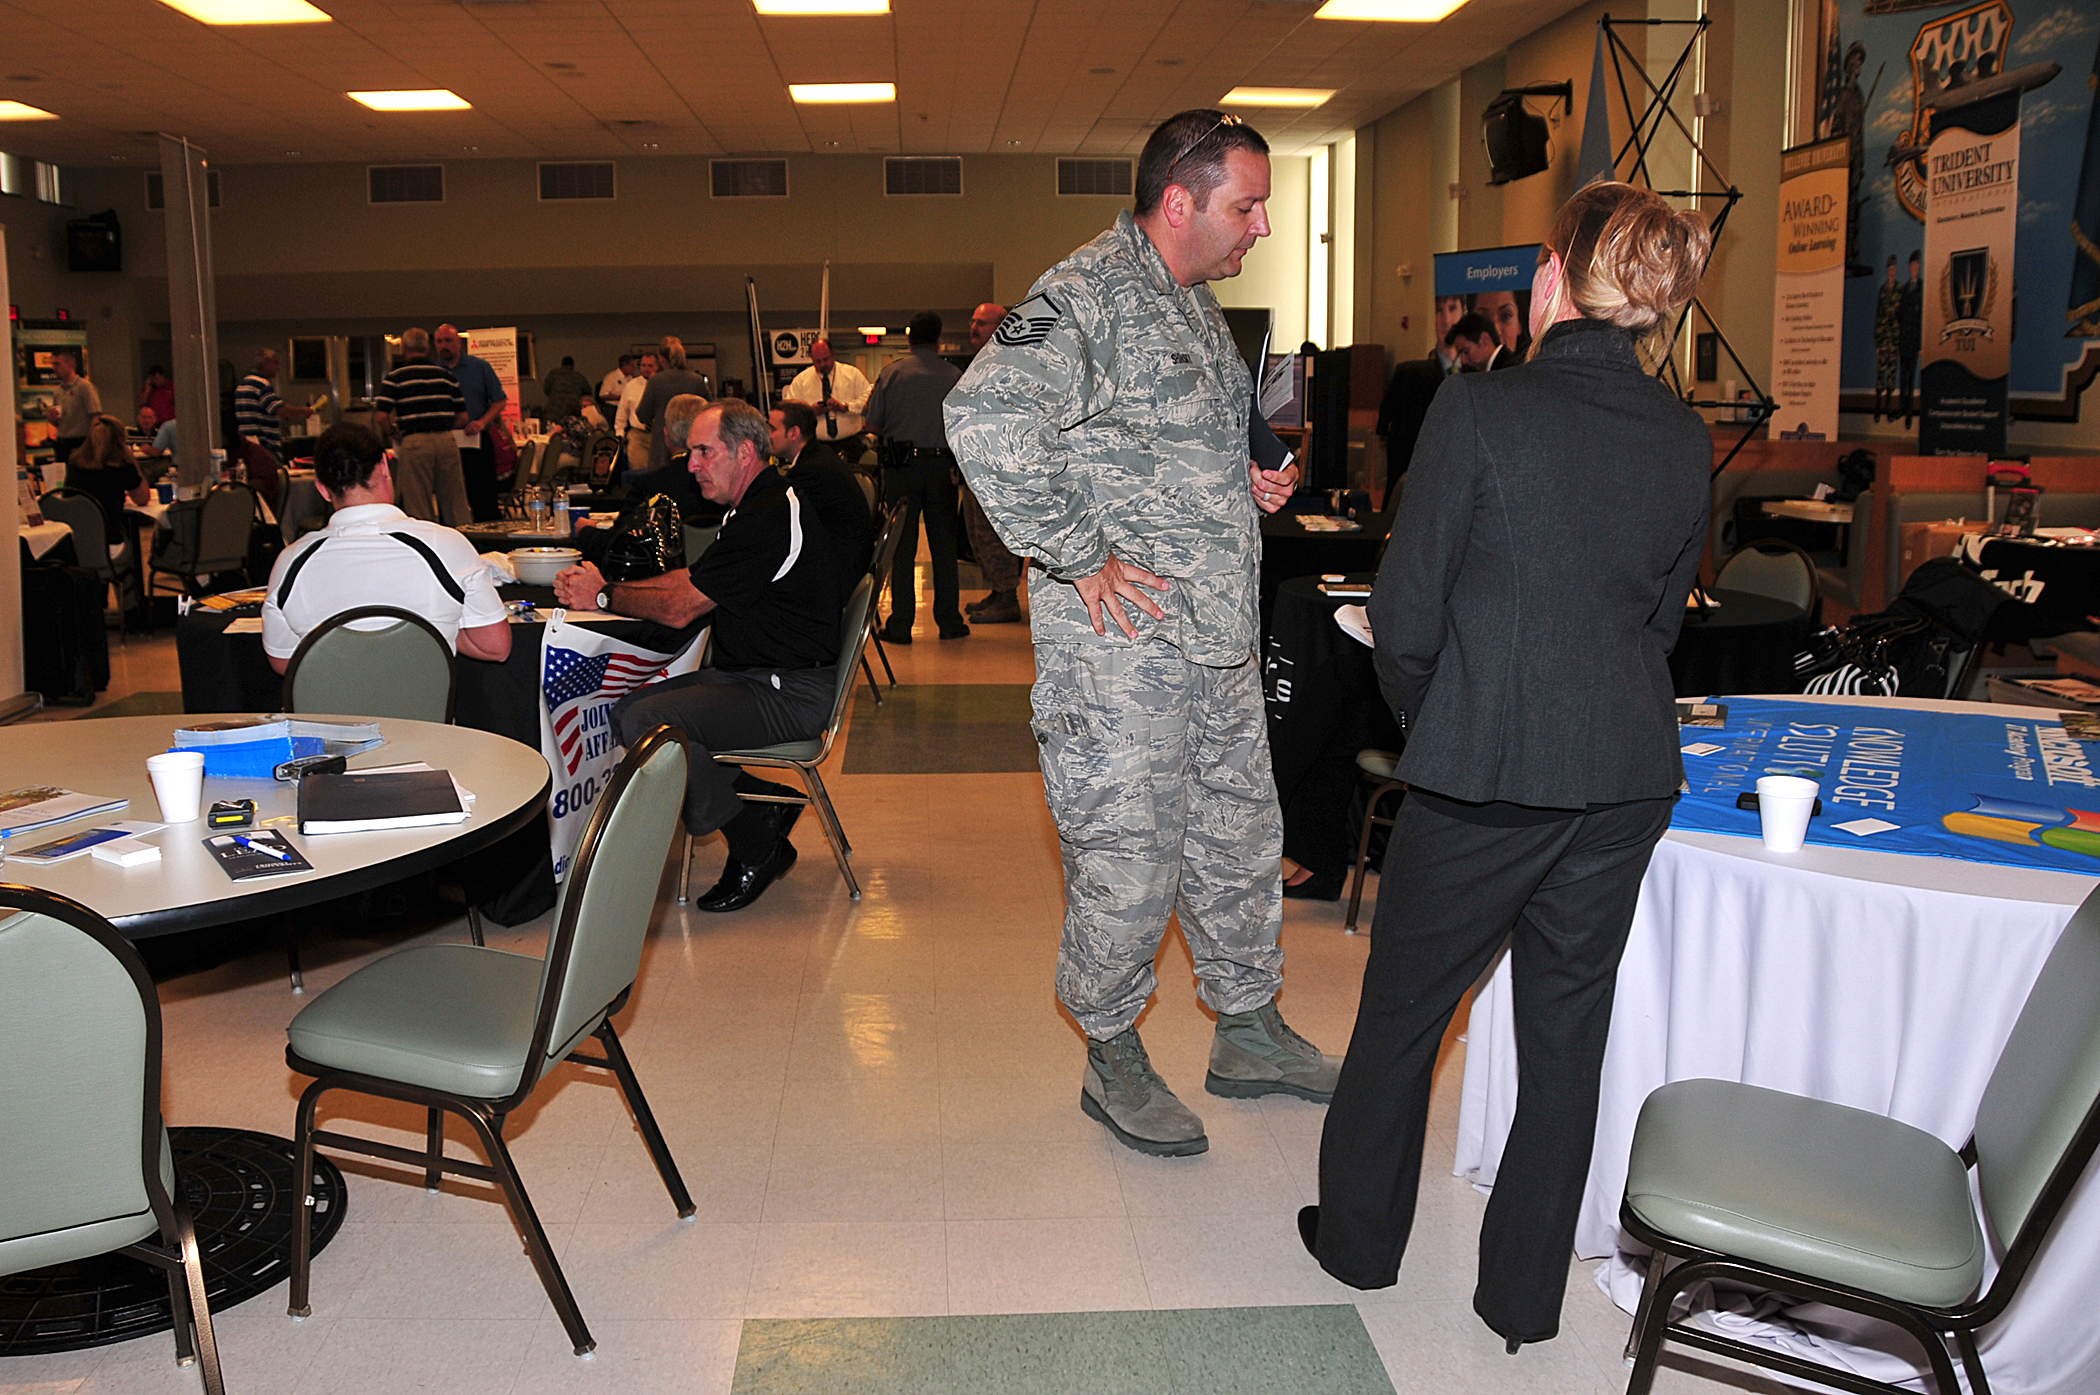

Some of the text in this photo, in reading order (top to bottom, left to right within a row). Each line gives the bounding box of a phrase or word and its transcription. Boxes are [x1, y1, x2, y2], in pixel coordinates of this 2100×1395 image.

[1933, 142, 1993, 174] TRIDENT
[1932, 159, 2016, 195] UNIVERSITY
[1783, 194, 1838, 222] AWARD-
[1793, 217, 1840, 237] WINNING
[1809, 237, 1837, 252] Learning
[1467, 265, 1519, 280] Employers
[1956, 337, 1976, 352] TUI
[1832, 726, 1906, 810] KNOWLEDGE
